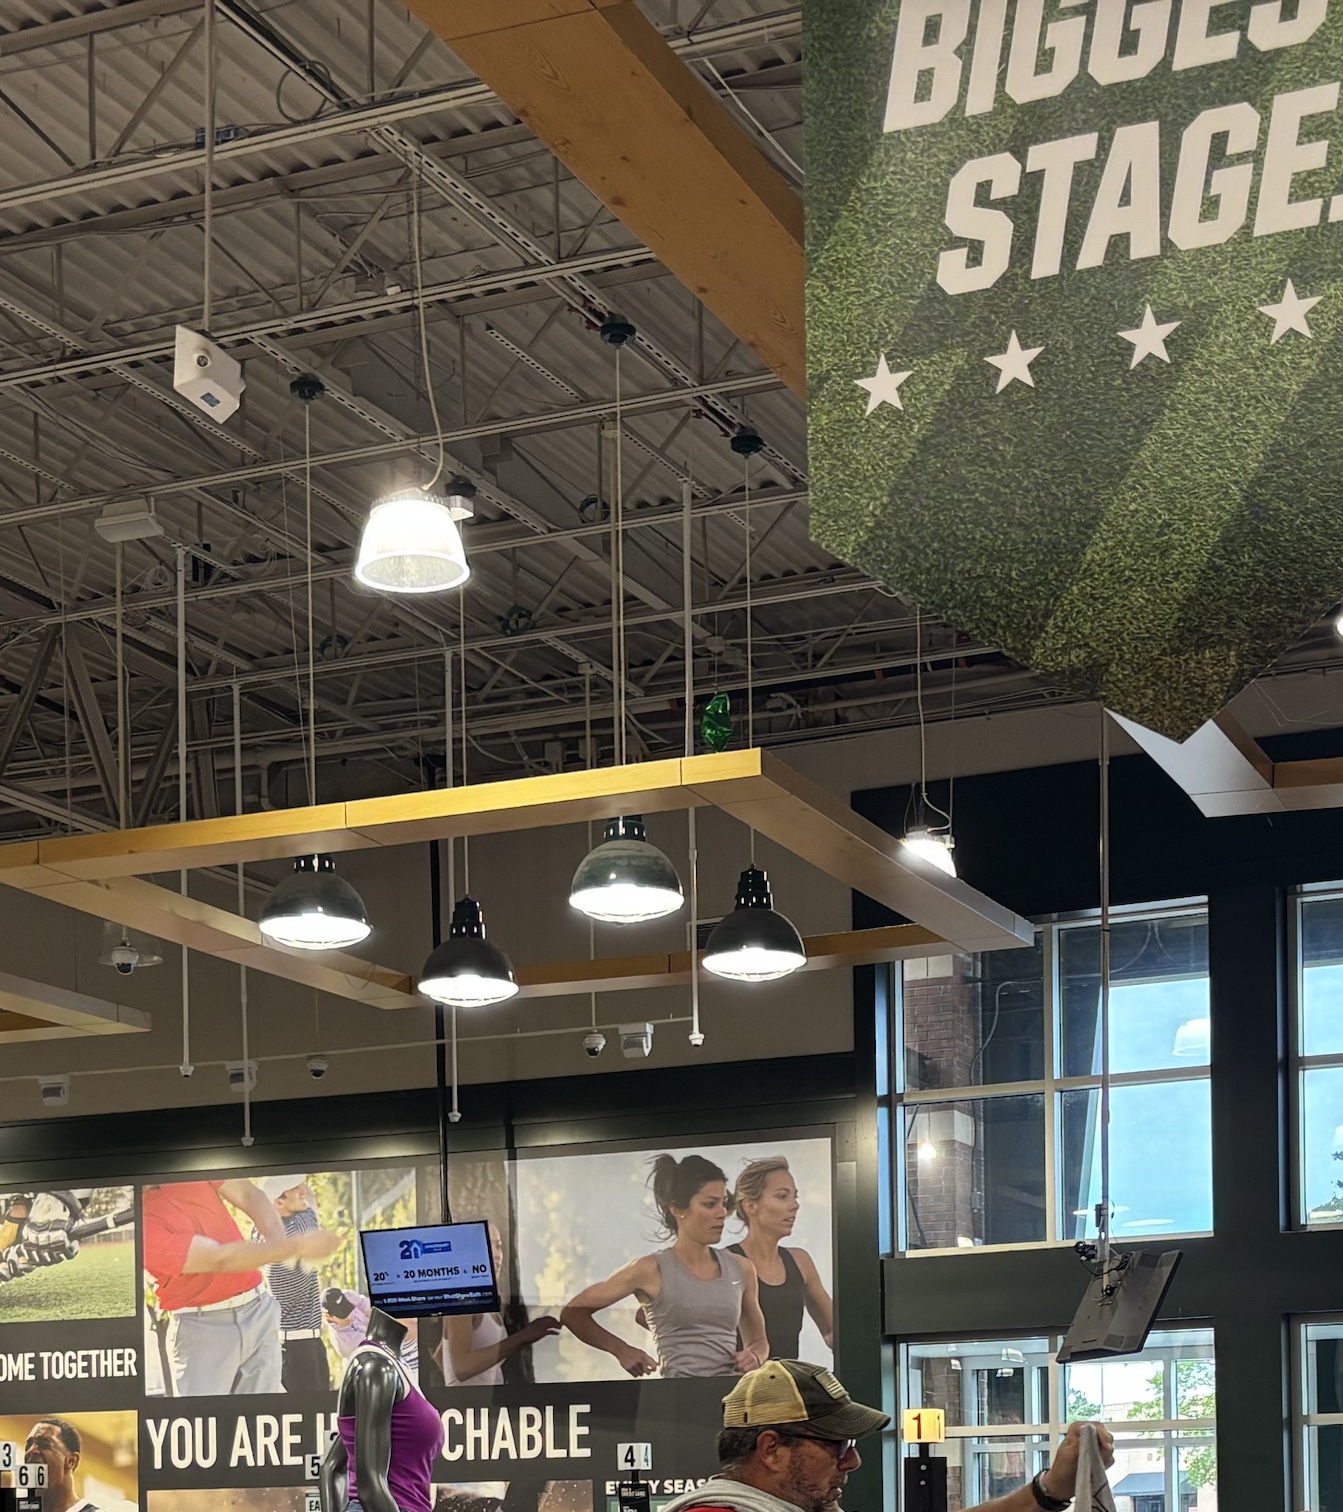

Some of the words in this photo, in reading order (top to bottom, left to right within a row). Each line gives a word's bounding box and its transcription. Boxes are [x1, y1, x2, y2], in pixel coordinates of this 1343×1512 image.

[417, 1266, 460, 1278] MONTHS
[472, 1264, 487, 1274] NO
[39, 1348, 138, 1380] TOGETHER
[912, 1412, 922, 1440] 1
[145, 1416, 218, 1470] YOU
[229, 1413, 304, 1468] ARE
[2, 1442, 12, 1468] 3
[310, 1456, 321, 1477] 5
[624, 1445, 636, 1468] 4
[18, 1465, 29, 1486] 6
[37, 1465, 45, 1486] 6
